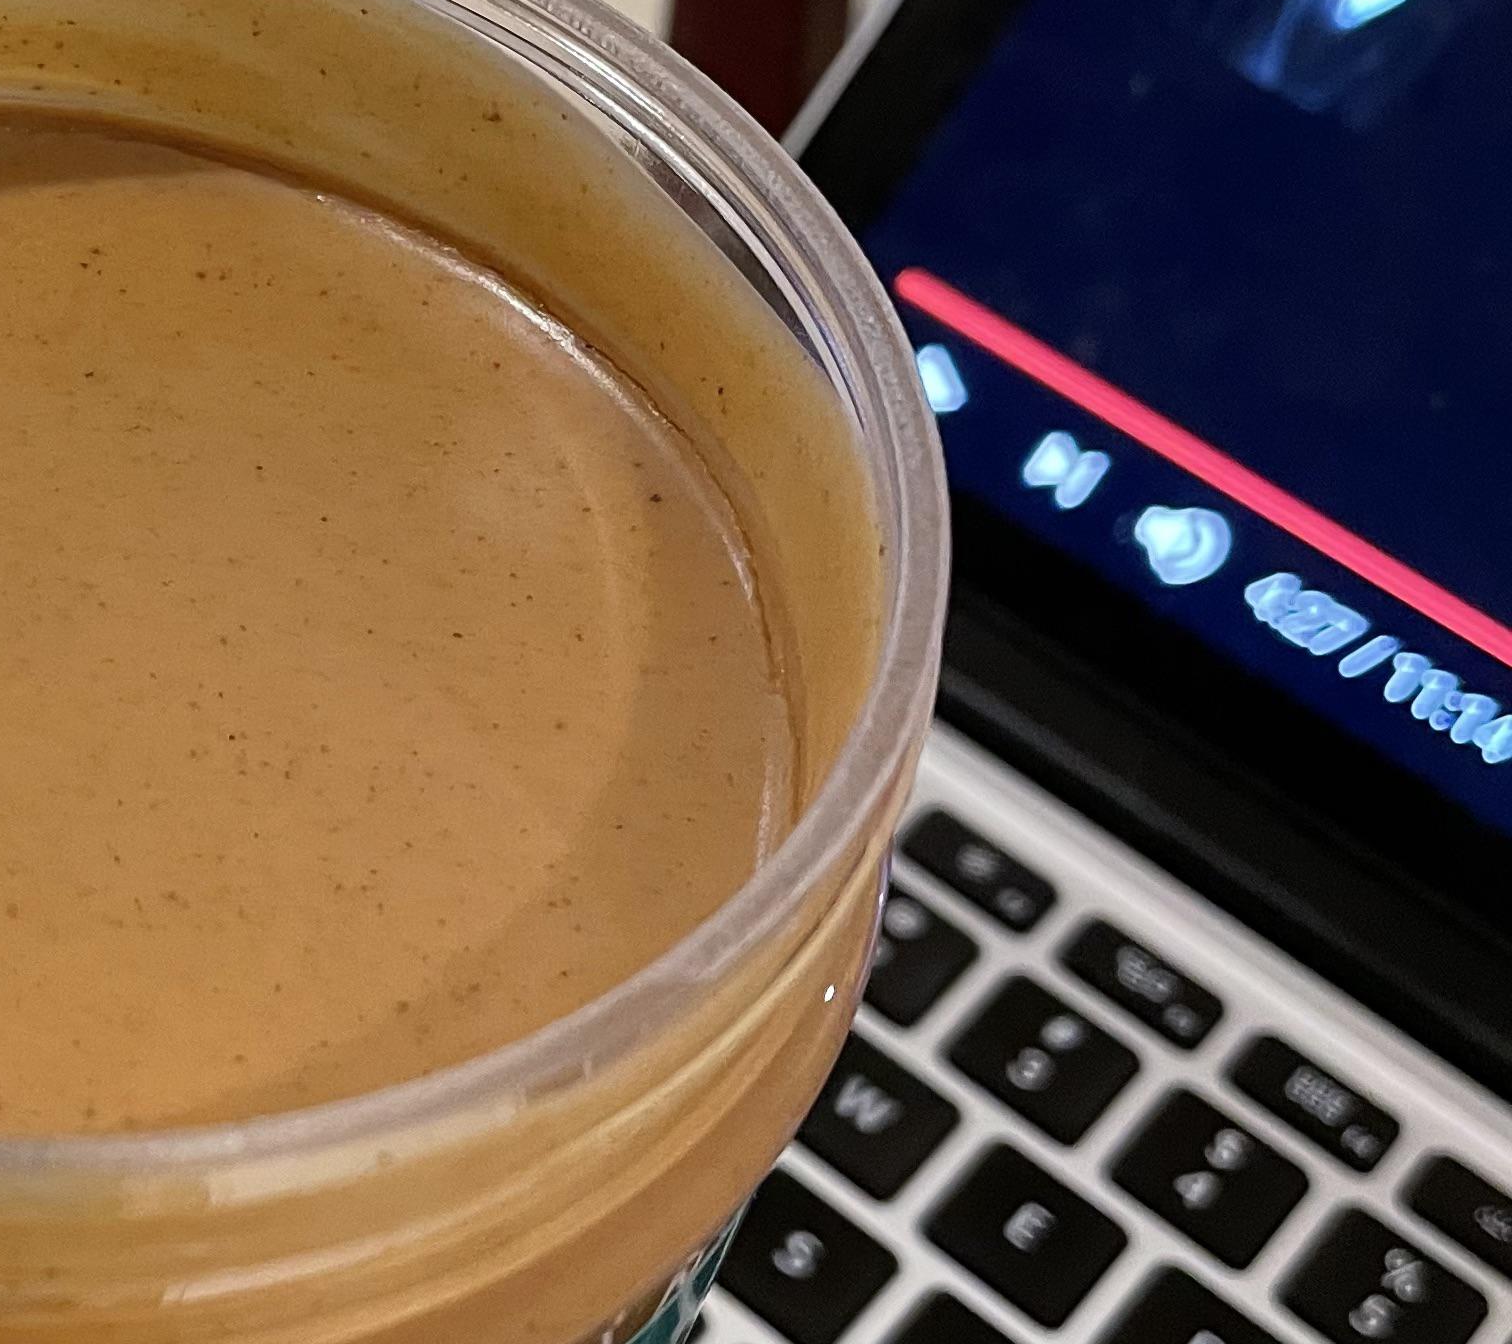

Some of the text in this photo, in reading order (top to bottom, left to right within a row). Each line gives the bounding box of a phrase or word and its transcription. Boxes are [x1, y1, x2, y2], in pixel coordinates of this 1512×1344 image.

[834, 1074, 896, 1133] W
[1003, 1201, 1055, 1251] E
[772, 1230, 825, 1278] S
[1349, 1294, 1395, 1338] 5
